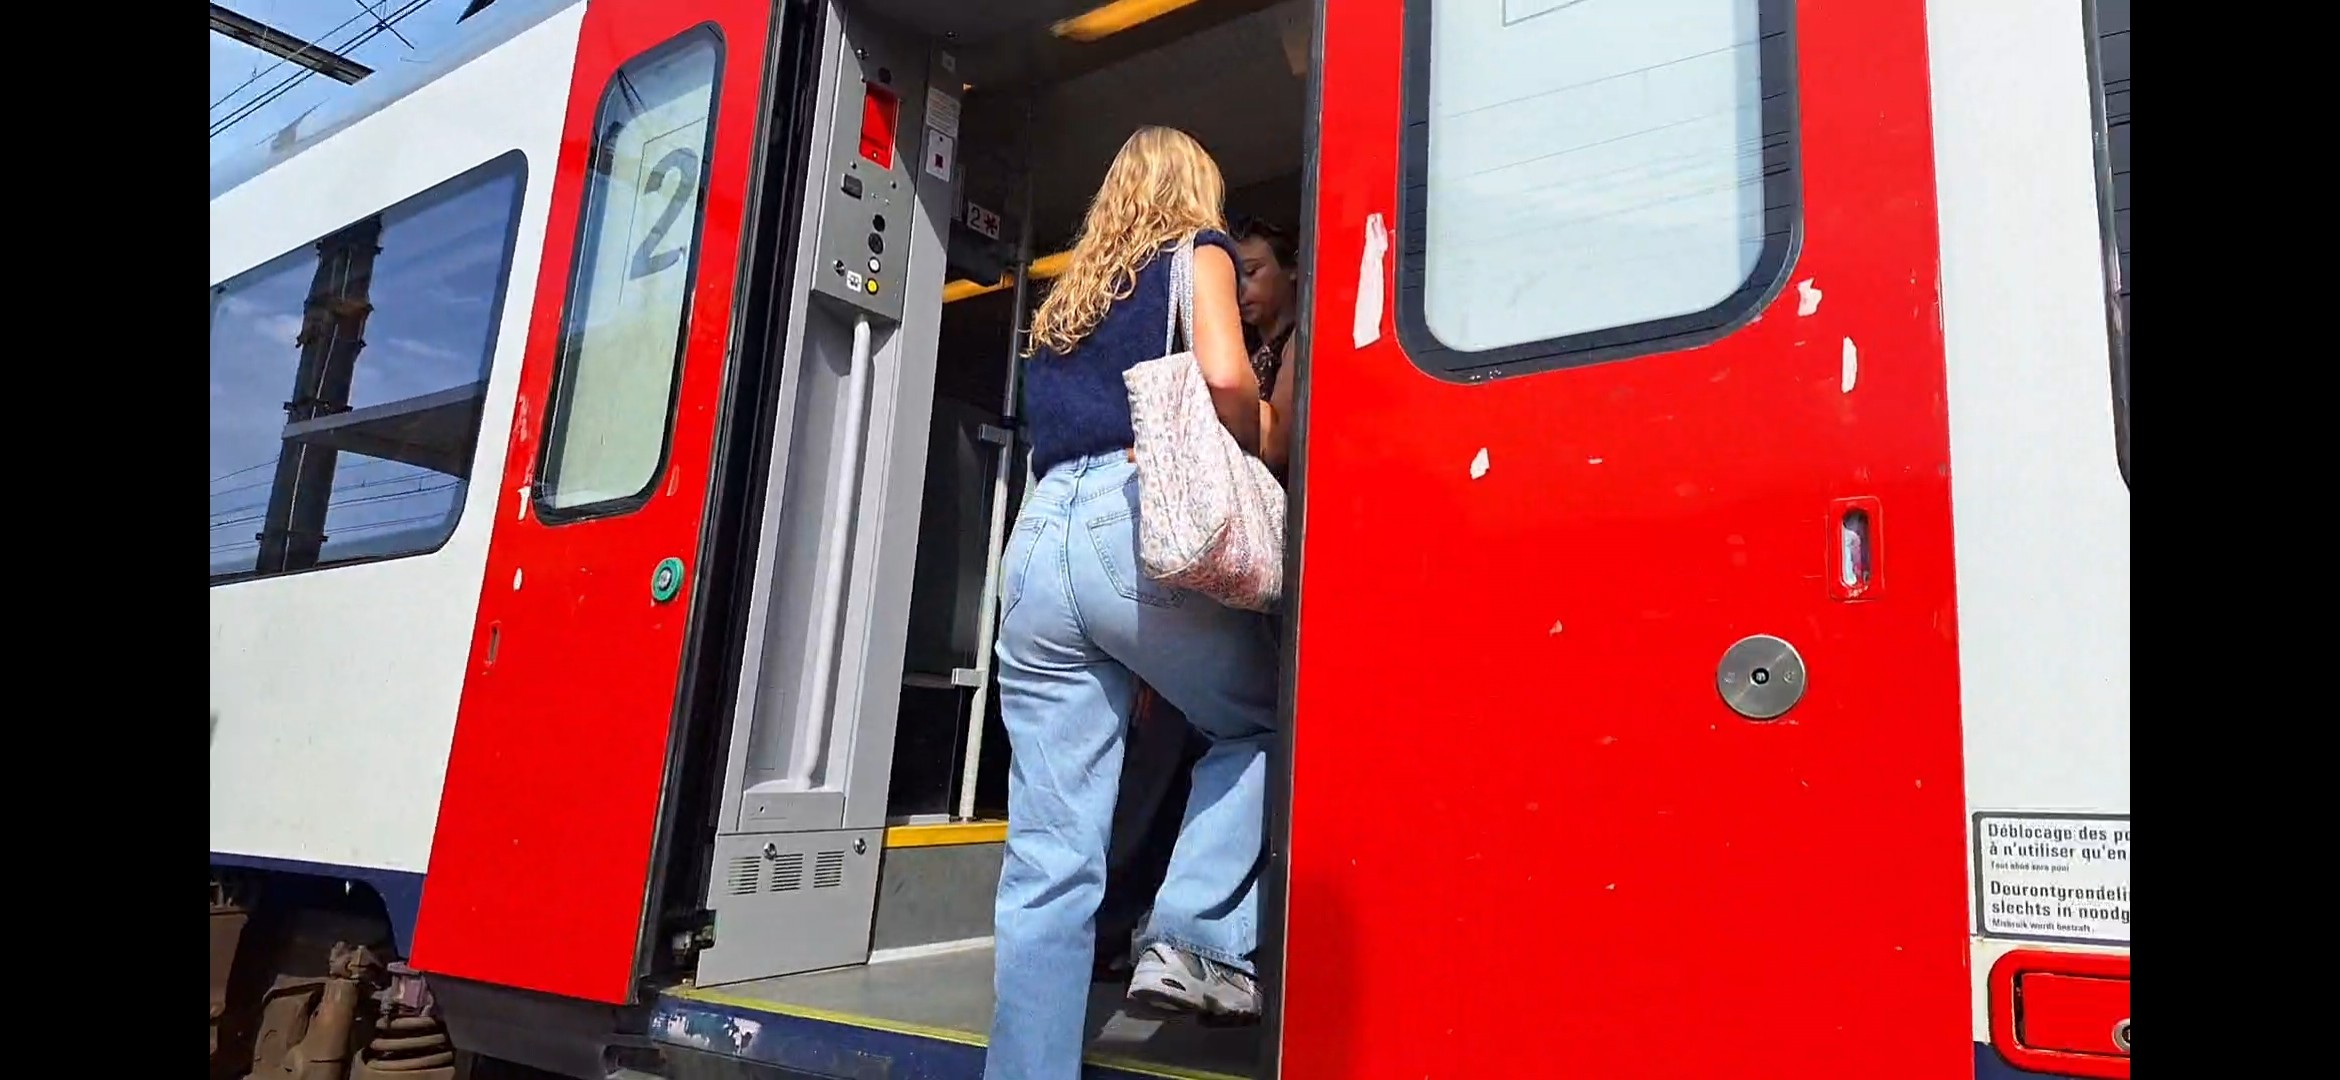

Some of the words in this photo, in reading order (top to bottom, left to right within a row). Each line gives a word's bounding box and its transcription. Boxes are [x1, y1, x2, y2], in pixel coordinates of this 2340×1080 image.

[629, 147, 698, 281] 2
[969, 207, 981, 229] 2
[1988, 823, 2072, 842] Déblocage
[2079, 826, 2107, 840] des
[1989, 842, 1998, 855] à
[2004, 842, 2074, 857] n'utiliser
[2082, 844, 2127, 862] qu'en
[1990, 880, 2130, 902] Deurontgrendeli
[1992, 900, 2051, 917] slechts
[2057, 903, 2072, 918] in
